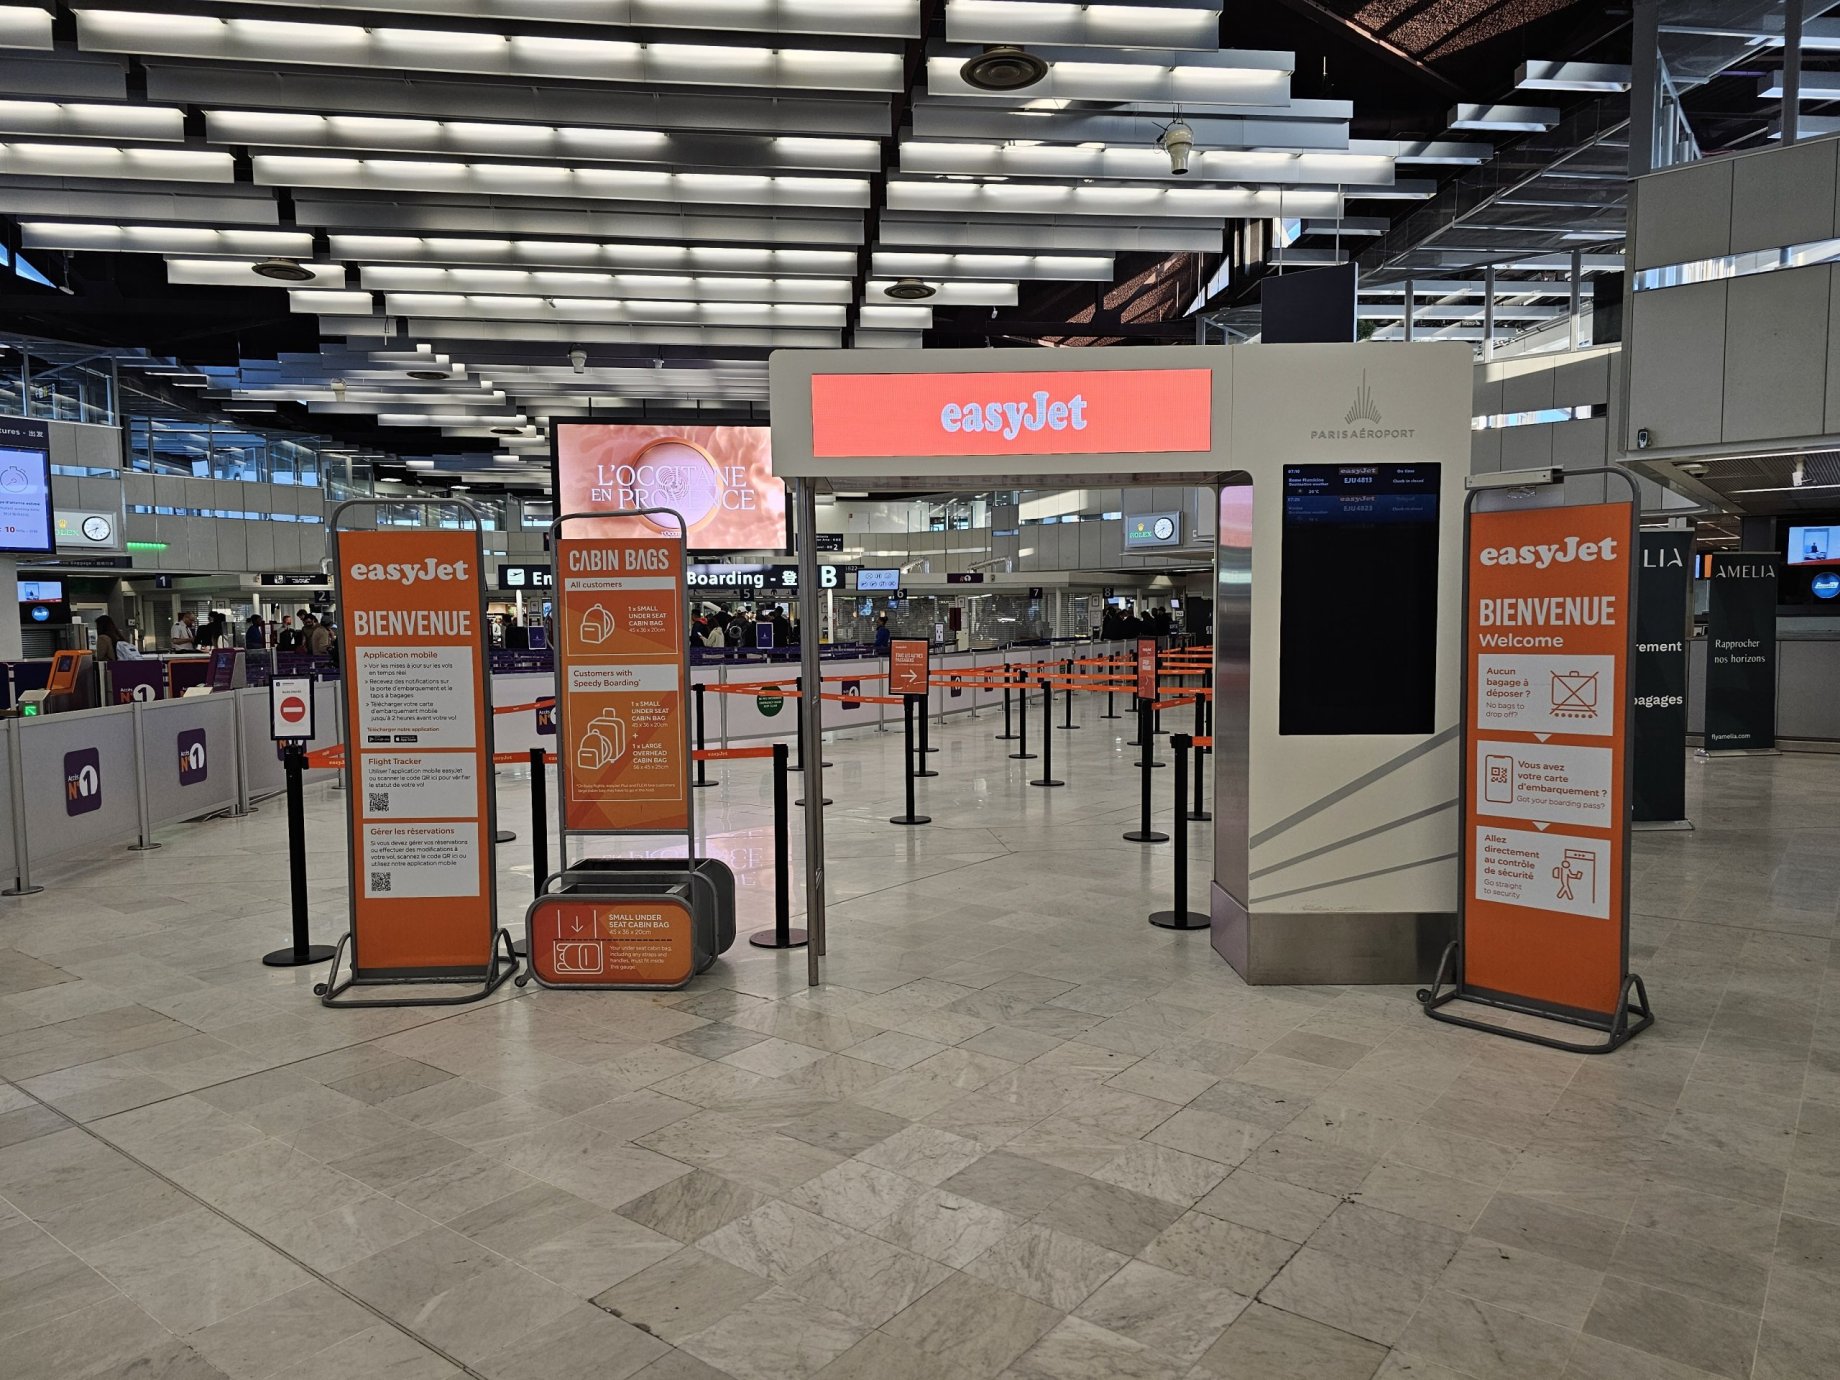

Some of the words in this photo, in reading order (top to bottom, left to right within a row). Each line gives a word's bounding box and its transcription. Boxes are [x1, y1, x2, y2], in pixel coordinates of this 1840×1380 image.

[941, 391, 1088, 440] easyJet
[1311, 430, 1348, 439] PARIS
[1350, 428, 1416, 439] AÉROPORT
[1340, 467, 1377, 475] easyJet
[591, 488, 612, 502] EN
[618, 489, 756, 511] PROVENCE
[1340, 495, 1376, 503] easyJet
[1129, 531, 1152, 539] ROLEX
[1480, 536, 1618, 569] easyJet
[569, 550, 619, 571] CABIN
[625, 549, 669, 570] BAGS
[351, 558, 469, 586] easyJet
[821, 565, 838, 588] B
[1715, 565, 1776, 579] AMELIA
[160, 576, 166, 587] 1
[687, 570, 764, 589] Boarding
[319, 591, 327, 601] 2
[743, 589, 751, 599] 5
[897, 590, 904, 599] 6
[1034, 589, 1039, 597] 7
[1105, 588, 1111, 597] 8
[1479, 596, 1616, 626] BIENVENUE
[353, 610, 472, 636] BIENVENUE
[1479, 633, 1564, 648] Welcome
[1715, 639, 1761, 650] Rapprocher
[363, 651, 408, 660] Application
[410, 651, 438, 659] mobile
[1714, 655, 1728, 663] nos
[1731, 654, 1766, 663] horizons
[1486, 667, 1516, 675] Aucun
[573, 680, 602, 688] Speedy
[1486, 678, 1521, 687] bagage
[1523, 677, 1529, 687] à
[1486, 689, 1523, 699] déposer
[1526, 690, 1531, 698] ?
[1498, 702, 1515, 711] bags
[1486, 710, 1502, 719] drop
[1504, 710, 1518, 718] off?
[368, 758, 391, 766] Flight
[1518, 760, 1541, 770] Vous
[1542, 763, 1565, 772] avez
[1517, 772, 1541, 781] votre
[1543, 774, 1569, 783] carte
[1517, 783, 1599, 798] d'embarquement
[1602, 789, 1608, 797] ?
[1517, 795, 1530, 803] Got
[1531, 797, 1548, 806] your
[1549, 798, 1581, 809] boarding
[1583, 802, 1605, 811] pass?
[407, 827, 455, 835] réservations
[1484, 834, 1507, 844] Allez
[1484, 845, 1540, 859] directement
[1484, 857, 1495, 865] au
[1497, 858, 1535, 870] contrôle
[1484, 867, 1495, 875] de
[1497, 867, 1534, 880] sécurité
[1495, 880, 1522, 890] straight
[1493, 889, 1520, 899] security
